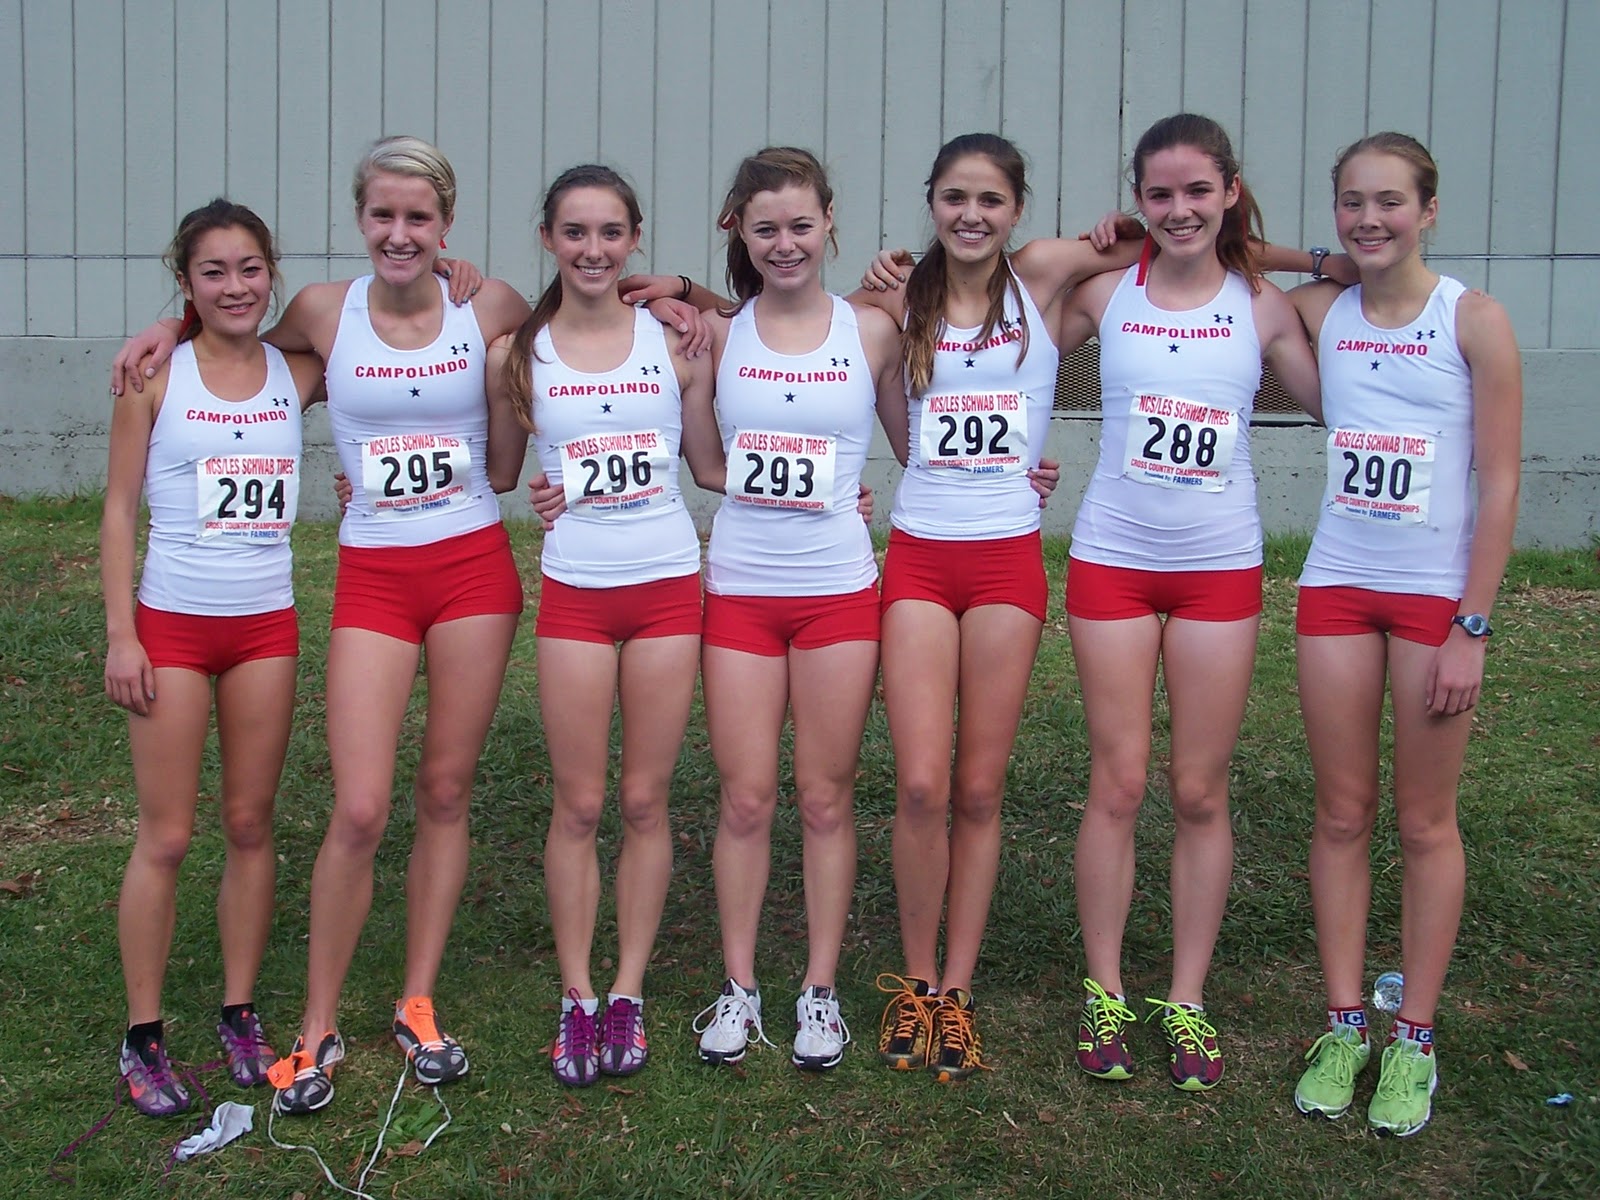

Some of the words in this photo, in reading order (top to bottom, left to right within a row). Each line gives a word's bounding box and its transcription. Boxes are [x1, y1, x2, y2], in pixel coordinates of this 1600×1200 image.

[1122, 322, 1231, 338] CAMPOLINDO
[356, 359, 468, 378] CAMPOLINDO
[739, 367, 847, 383] CAMPOLINDO
[549, 383, 659, 397] CAMPOLINDO
[929, 396, 959, 413] NCS/LES
[961, 395, 994, 412] SCHWAB
[997, 393, 1018, 411] TIRES
[1139, 395, 1173, 417] NCS/LES
[1174, 401, 1208, 422] SCHWAB
[1208, 409, 1230, 425] TIRES
[186, 410, 287, 423] CAMPOLINDO
[737, 433, 768, 451] NCS/LES
[770, 435, 802, 454] SCHWAB
[805, 439, 827, 455] TIRES
[938, 414, 1009, 456] 292
[1143, 417, 1217, 467] 288
[1334, 431, 1364, 449] NCS/LES
[1366, 433, 1400, 452] SCHWAB
[1403, 437, 1426, 456] TIRES
[370, 436, 400, 456] NCS/LES
[402, 435, 435, 451] SCHWAB
[437, 436, 459, 447] TIRES
[566, 438, 598, 460] NCS/LES
[600, 435, 632, 452] SCHWAB
[634, 432, 657, 449] TIRES
[205, 459, 239, 475] NCS/LES
[242, 459, 273, 475] SCHWAB
[277, 459, 294, 475] TIRES
[974, 456, 1020, 466] CHAMPIONSHIPS
[1131, 459, 1147, 470] CROSS
[1149, 462, 1174, 474] COUNTRY
[1176, 467, 1219, 478] CHAMPIONSHIPS
[380, 451, 453, 497] 295
[580, 452, 651, 497] 296
[744, 453, 814, 498] 293
[1173, 475, 1202, 485] FARMERS
[1343, 451, 1412, 500] 290
[218, 478, 285, 519] 294
[376, 499, 393, 508] CROSS
[395, 497, 420, 507] COUNTRY
[422, 485, 463, 503] CHAMPIONSHIPS
[422, 498, 450, 510] FARMERS
[595, 495, 619, 505] COUNTRY
[621, 486, 663, 503] CHAMPIONSHIPS
[621, 498, 650, 509] FARMERS
[735, 495, 752, 503] CROSS
[753, 497, 777, 505] COUNTRY
[779, 499, 824, 509] CHAMPIONSHIPS
[1335, 495, 1349, 504] CROSS
[1350, 497, 1370, 508] COUNTRY
[1371, 500, 1419, 513] CHAMPIONSHIPS
[1369, 510, 1400, 520] FARMERS
